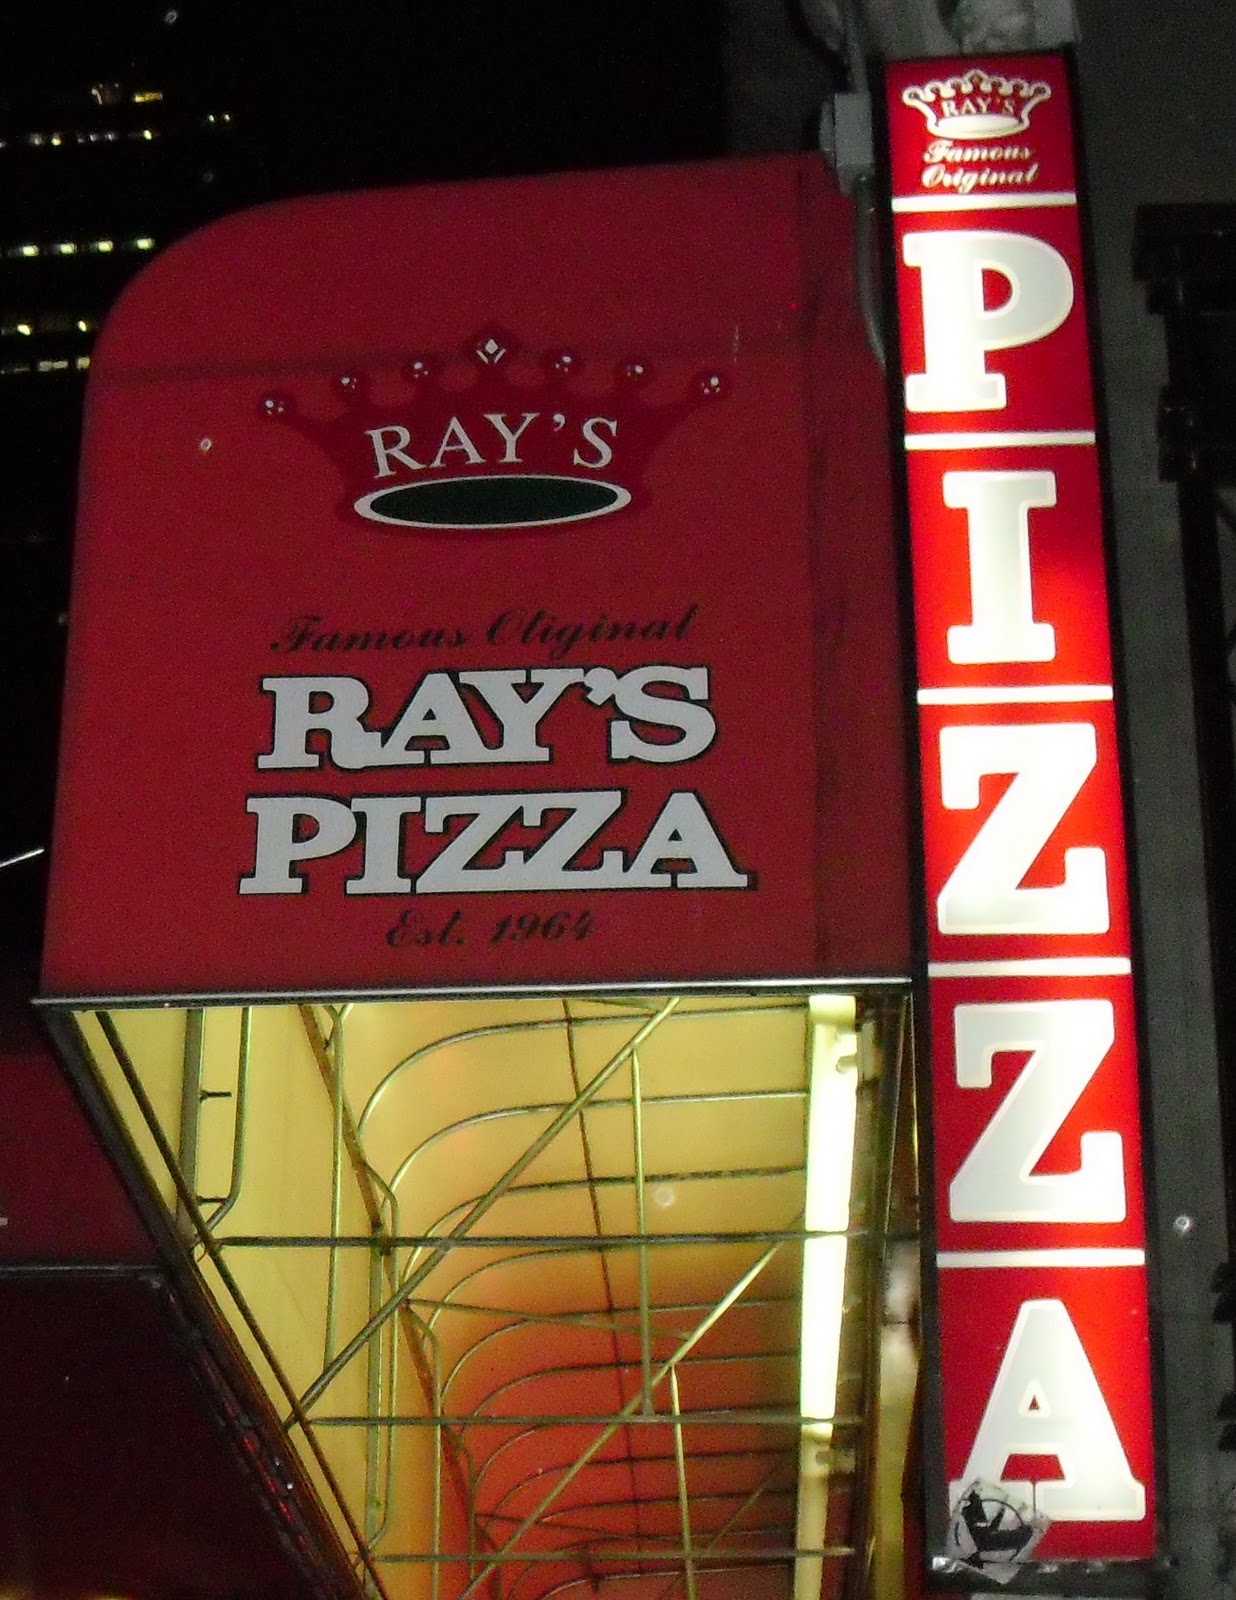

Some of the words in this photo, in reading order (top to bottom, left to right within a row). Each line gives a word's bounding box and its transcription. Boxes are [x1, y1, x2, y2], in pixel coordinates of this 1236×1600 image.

[942, 97, 1016, 117] RAY'S
[923, 140, 1032, 163] Famous
[921, 163, 1039, 194] Original
[364, 412, 619, 478] RAY'S
[270, 615, 465, 652] Famous
[256, 664, 717, 771] RAY'S
[238, 790, 750, 896] PIZZA
[903, 229, 1148, 1522] PIZZA
[489, 910, 594, 944] 1964
